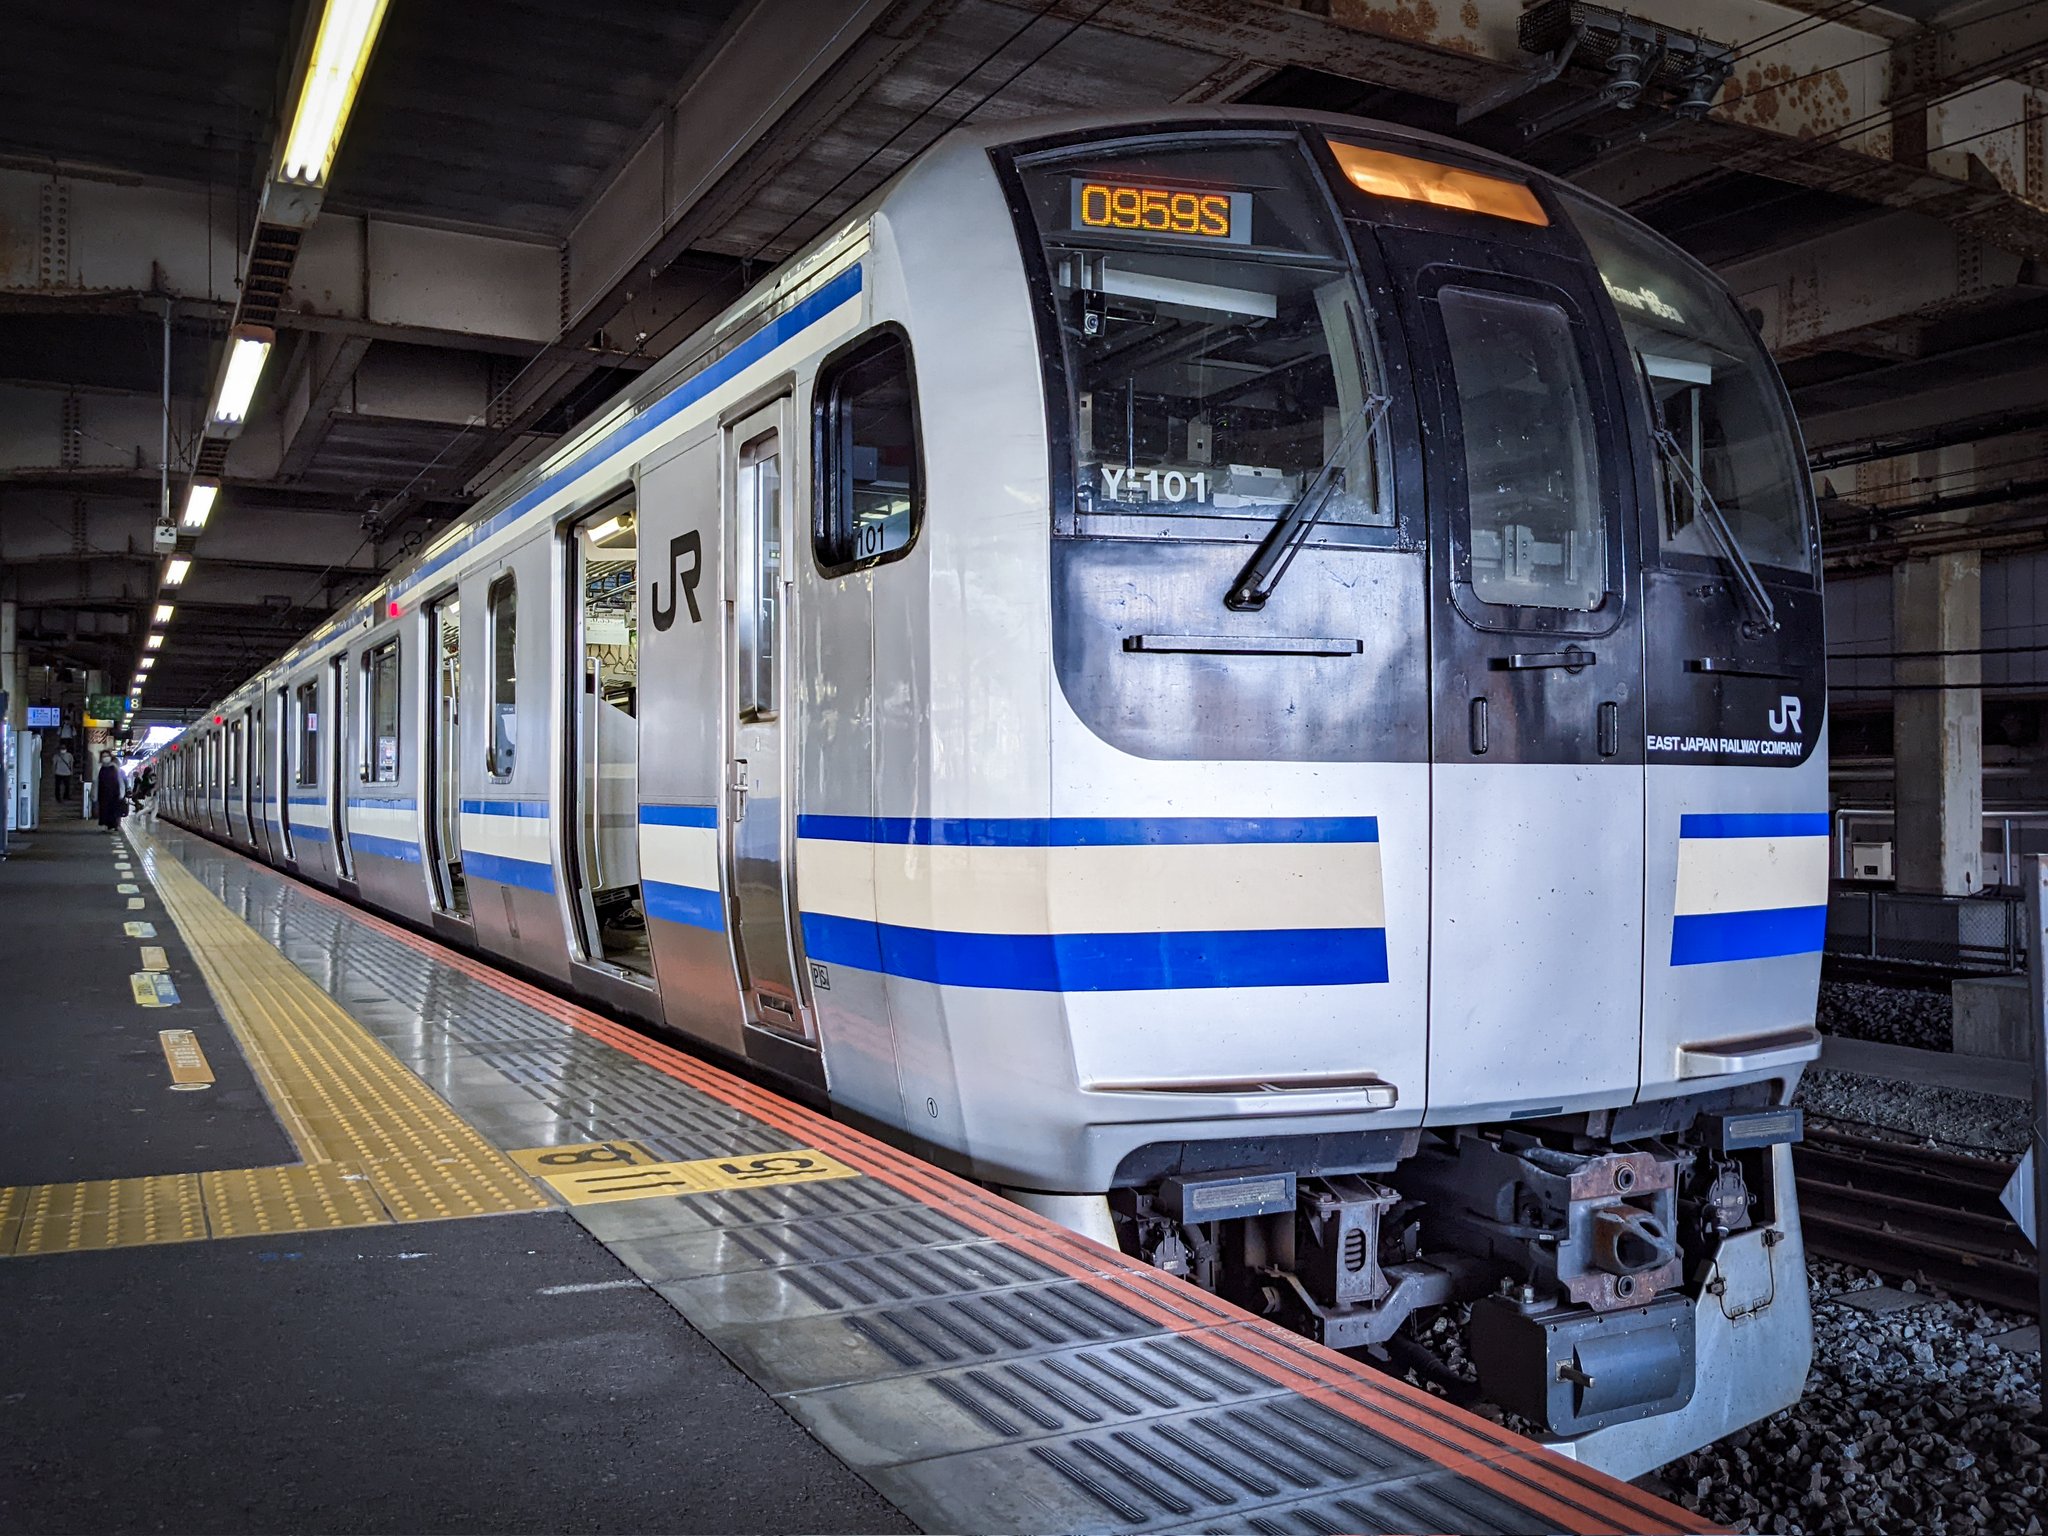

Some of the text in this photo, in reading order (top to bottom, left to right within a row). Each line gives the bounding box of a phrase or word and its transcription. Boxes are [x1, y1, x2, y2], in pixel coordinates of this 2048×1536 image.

[1082, 183, 1230, 235] 0959S
[1101, 467, 1207, 504] Y-101
[857, 522, 885, 557] 101
[651, 529, 702, 632] JR
[130, 698, 139, 709] 8
[1769, 695, 1802, 733] JR
[1647, 735, 1803, 756] EAST JAPAN RAILWAY COMPANY
